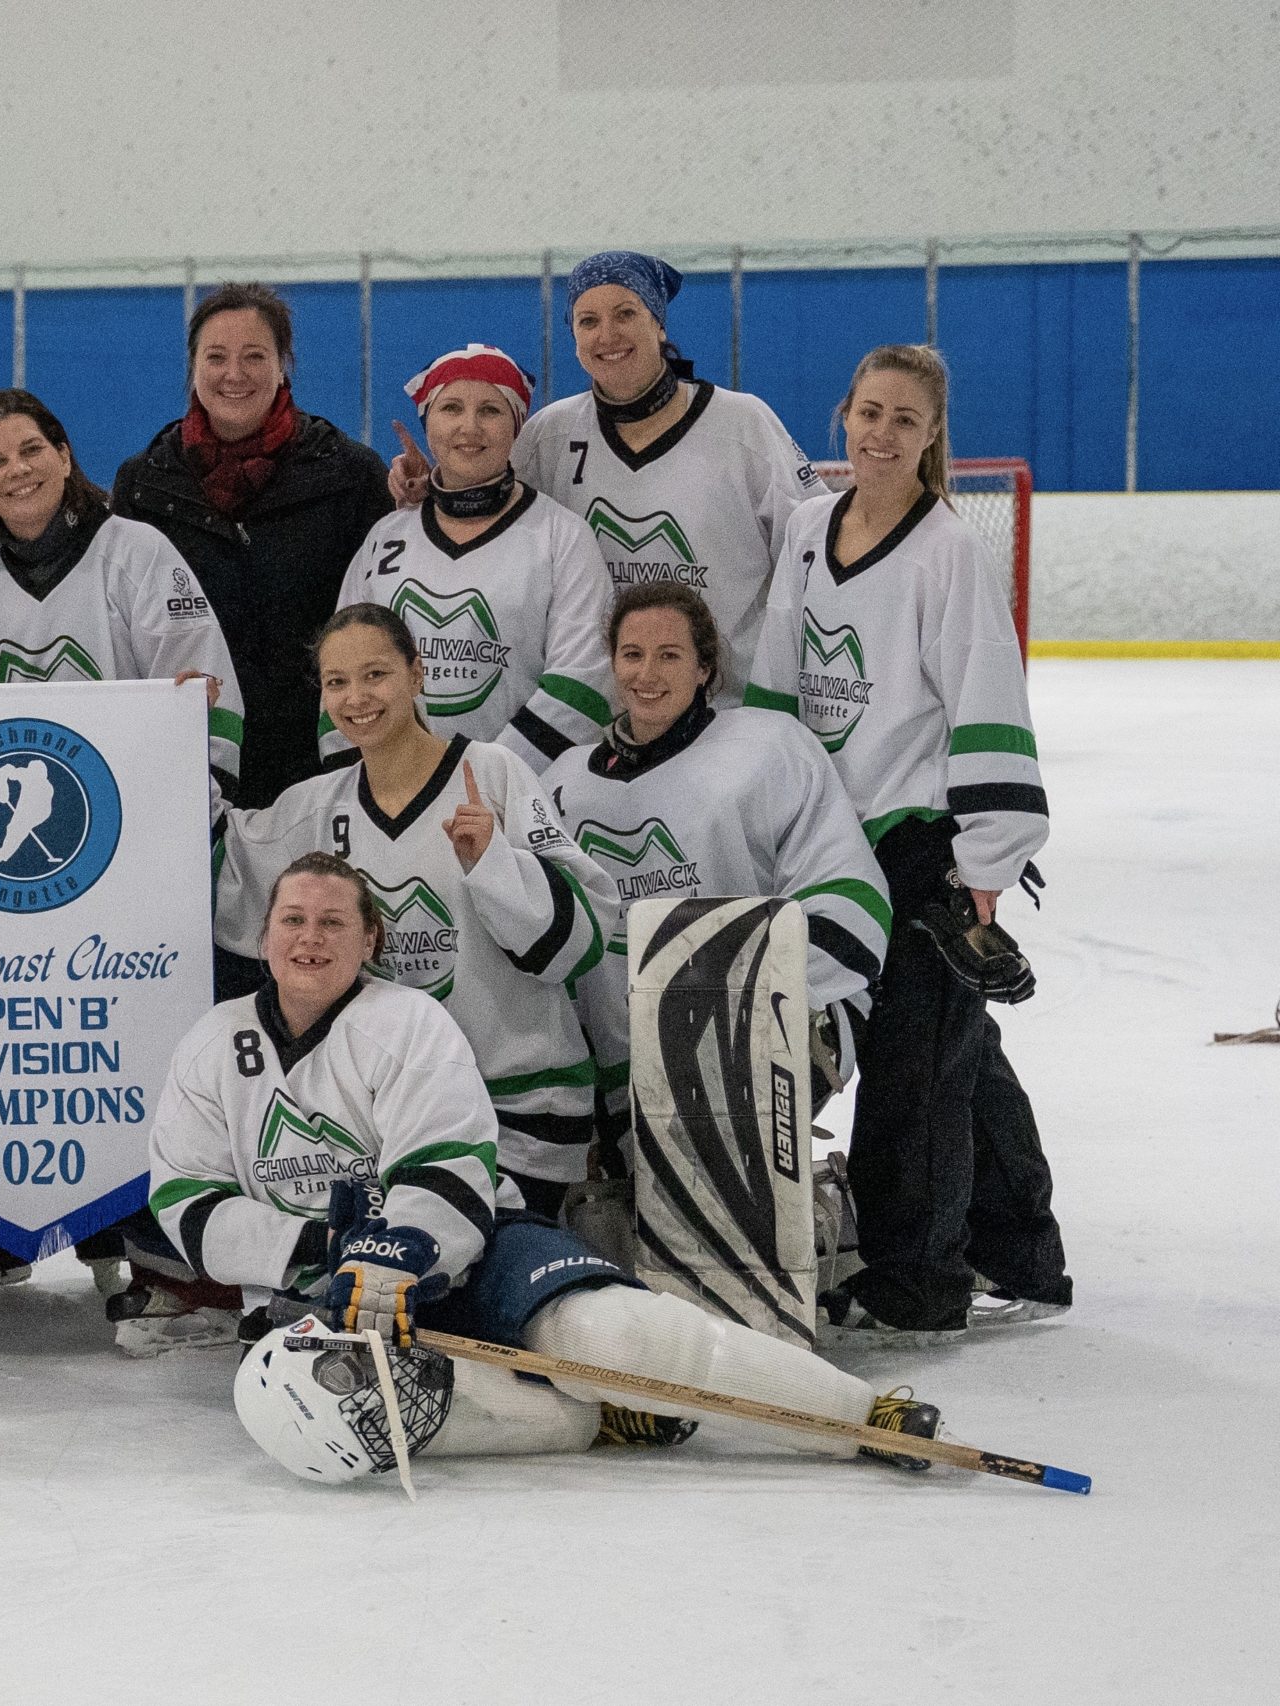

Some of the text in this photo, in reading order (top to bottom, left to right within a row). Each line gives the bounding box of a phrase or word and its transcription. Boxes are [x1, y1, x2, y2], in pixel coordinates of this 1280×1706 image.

[570, 441, 588, 484] 7
[607, 562, 709, 588] LLIWACK
[167, 597, 208, 611] GDS
[420, 637, 512, 668] LIWACK
[422, 666, 478, 680] ngette
[332, 815, 351, 860] 9
[617, 862, 702, 900] LIWACK
[66, 934, 179, 981] Classic
[233, 1029, 265, 1078] 8
[363, 1182, 384, 1220] bok
[341, 1235, 408, 1261] eebok
